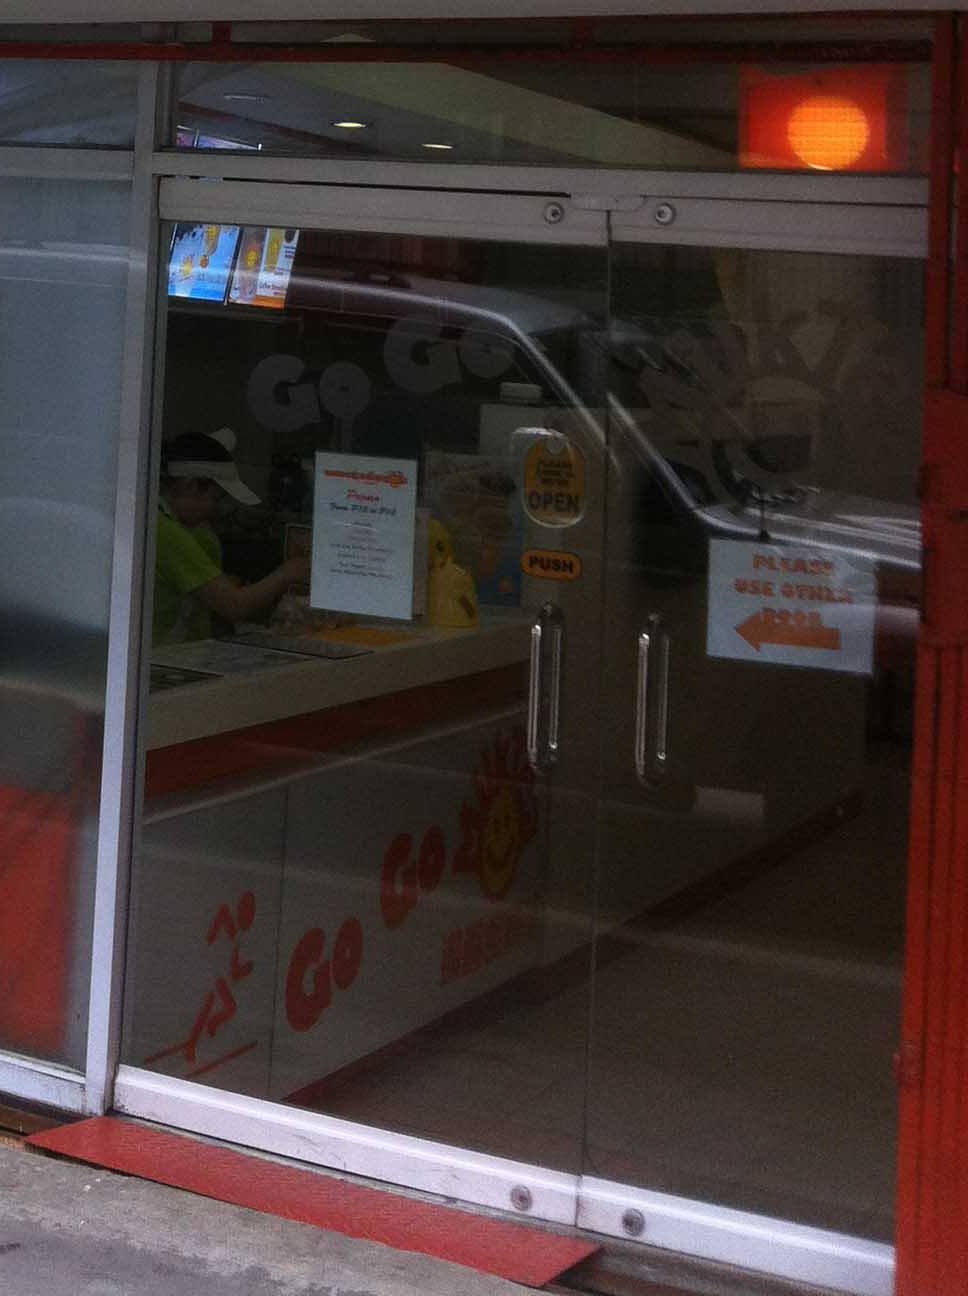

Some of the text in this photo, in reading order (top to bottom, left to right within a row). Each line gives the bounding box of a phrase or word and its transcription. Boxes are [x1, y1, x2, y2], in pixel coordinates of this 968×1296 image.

[529, 490, 580, 513] OPEN
[528, 554, 575, 574] PUSH
[734, 577, 775, 597] USE
